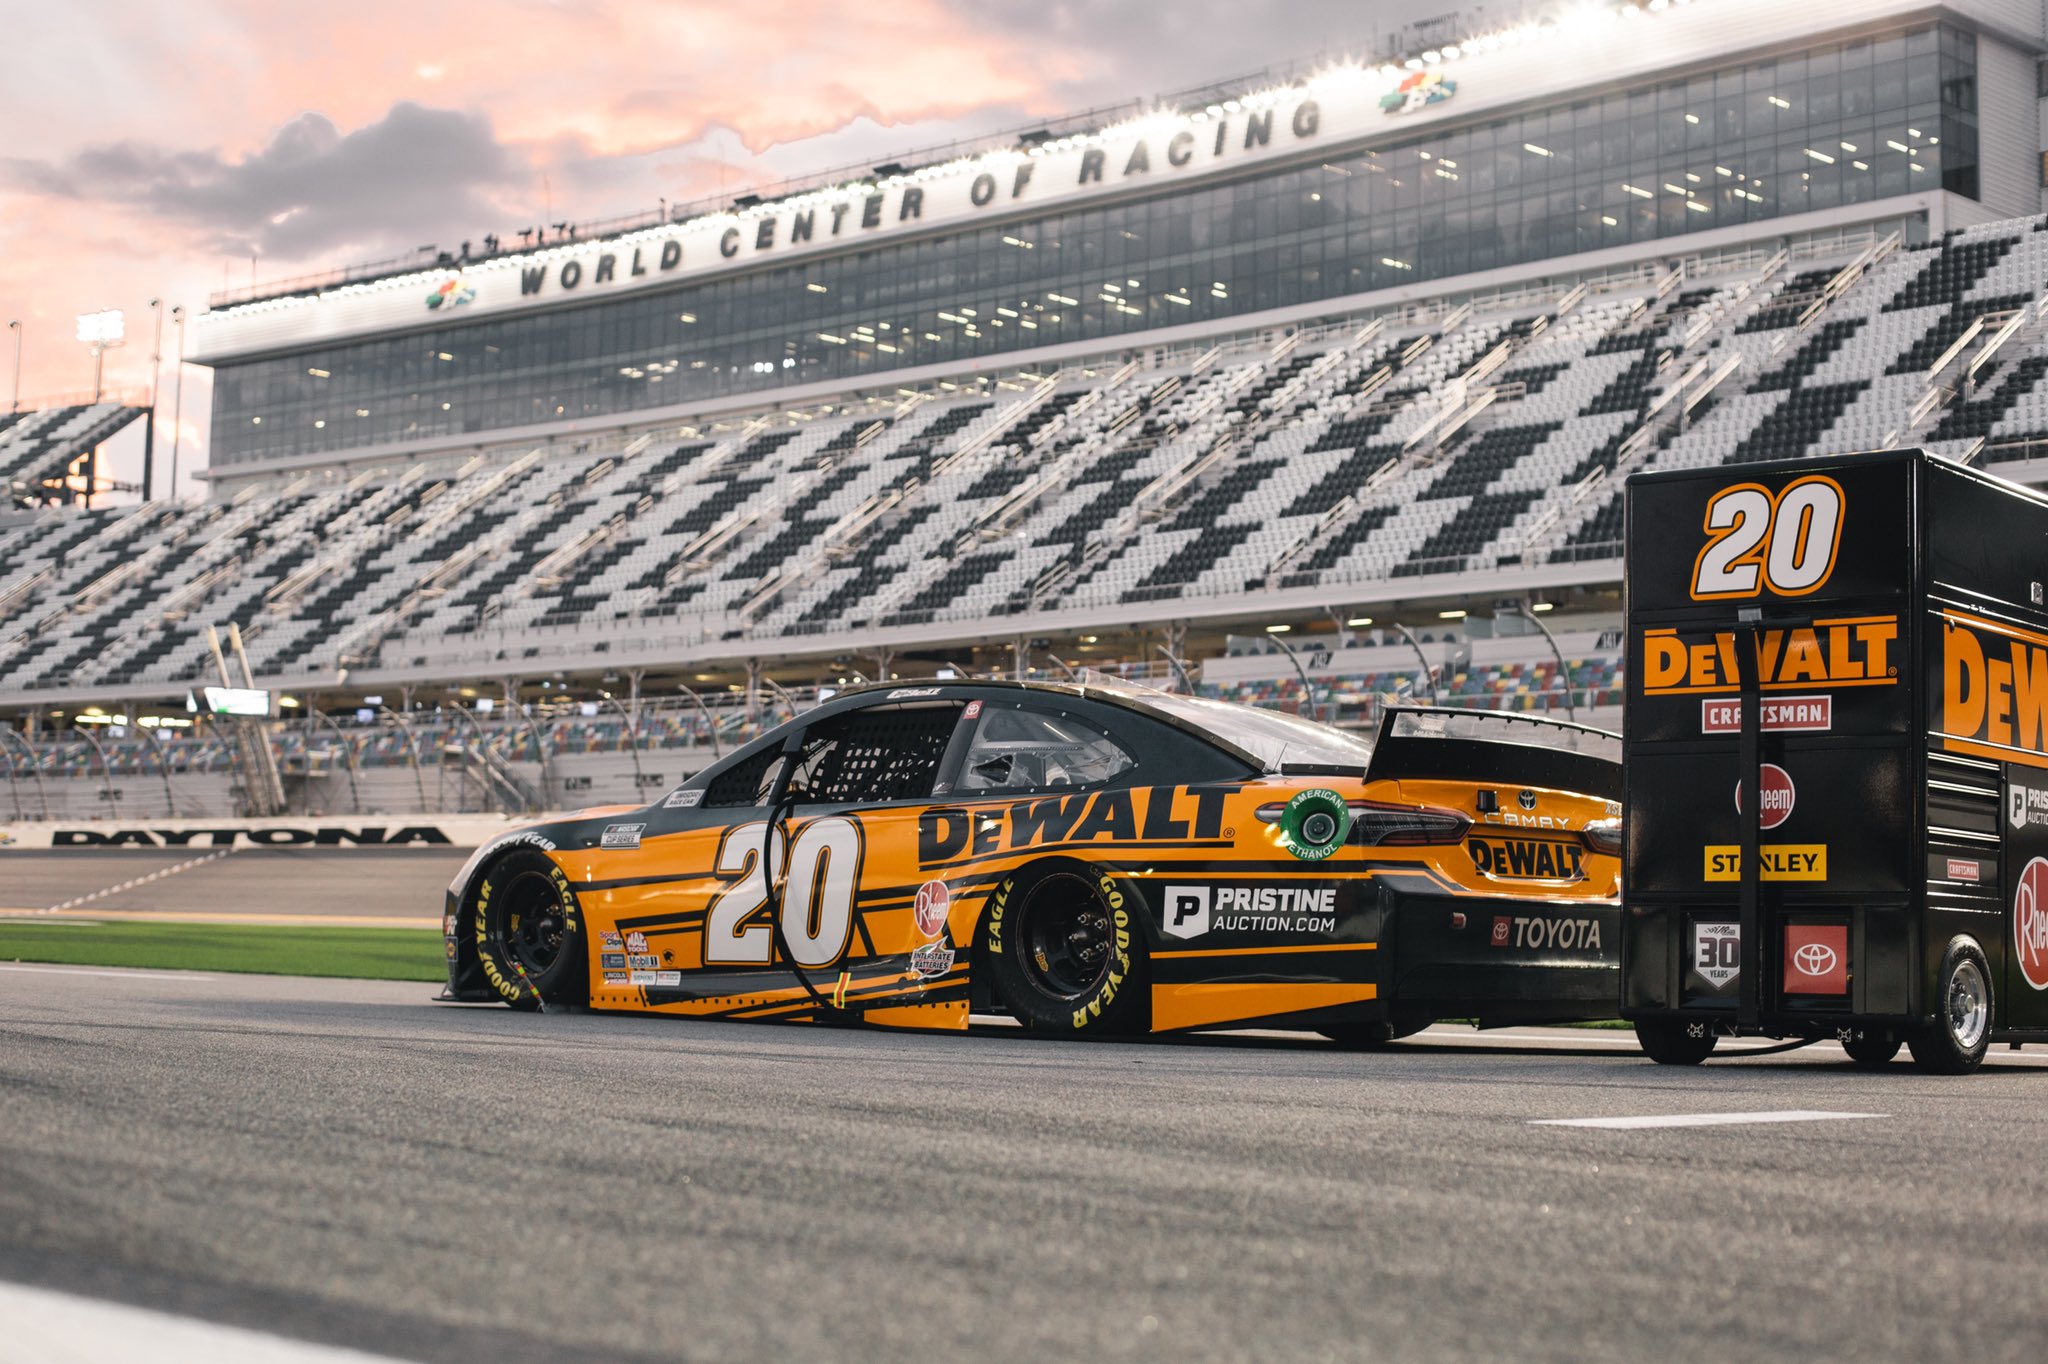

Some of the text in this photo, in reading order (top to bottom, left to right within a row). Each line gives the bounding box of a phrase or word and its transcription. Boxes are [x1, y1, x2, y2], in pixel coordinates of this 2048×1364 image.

[521, 100, 1320, 296] WORLD CENTER OF RACING
[1692, 476, 1844, 598] 20
[1710, 704, 1822, 725] CRATSMAN
[1291, 789, 1343, 809] AMERICAN
[2013, 792, 2023, 818] P
[52, 826, 453, 847] DAYTONA
[918, 784, 1241, 863] DEWALT
[1288, 843, 1337, 859] ETHANOL
[1467, 839, 1585, 878] DEWALT
[1712, 853, 1819, 873] STNLEY
[550, 866, 577, 933] EAGLE
[704, 815, 862, 969] 20
[918, 882, 948, 928] Rheem
[1214, 887, 1337, 912] PRISTINE
[988, 877, 1015, 954] EAGLE
[1173, 895, 1201, 926] P
[1213, 915, 1336, 932] AUCTION.COM
[1514, 917, 1601, 949] TOYOTA
[913, 952, 951, 961] INTERSTATE
[914, 961, 949, 970] BATTERIES
[1072, 875, 1130, 1028] GOODYEAR
[1699, 936, 1740, 968] 30
[1709, 969, 1729, 978] YEARS
